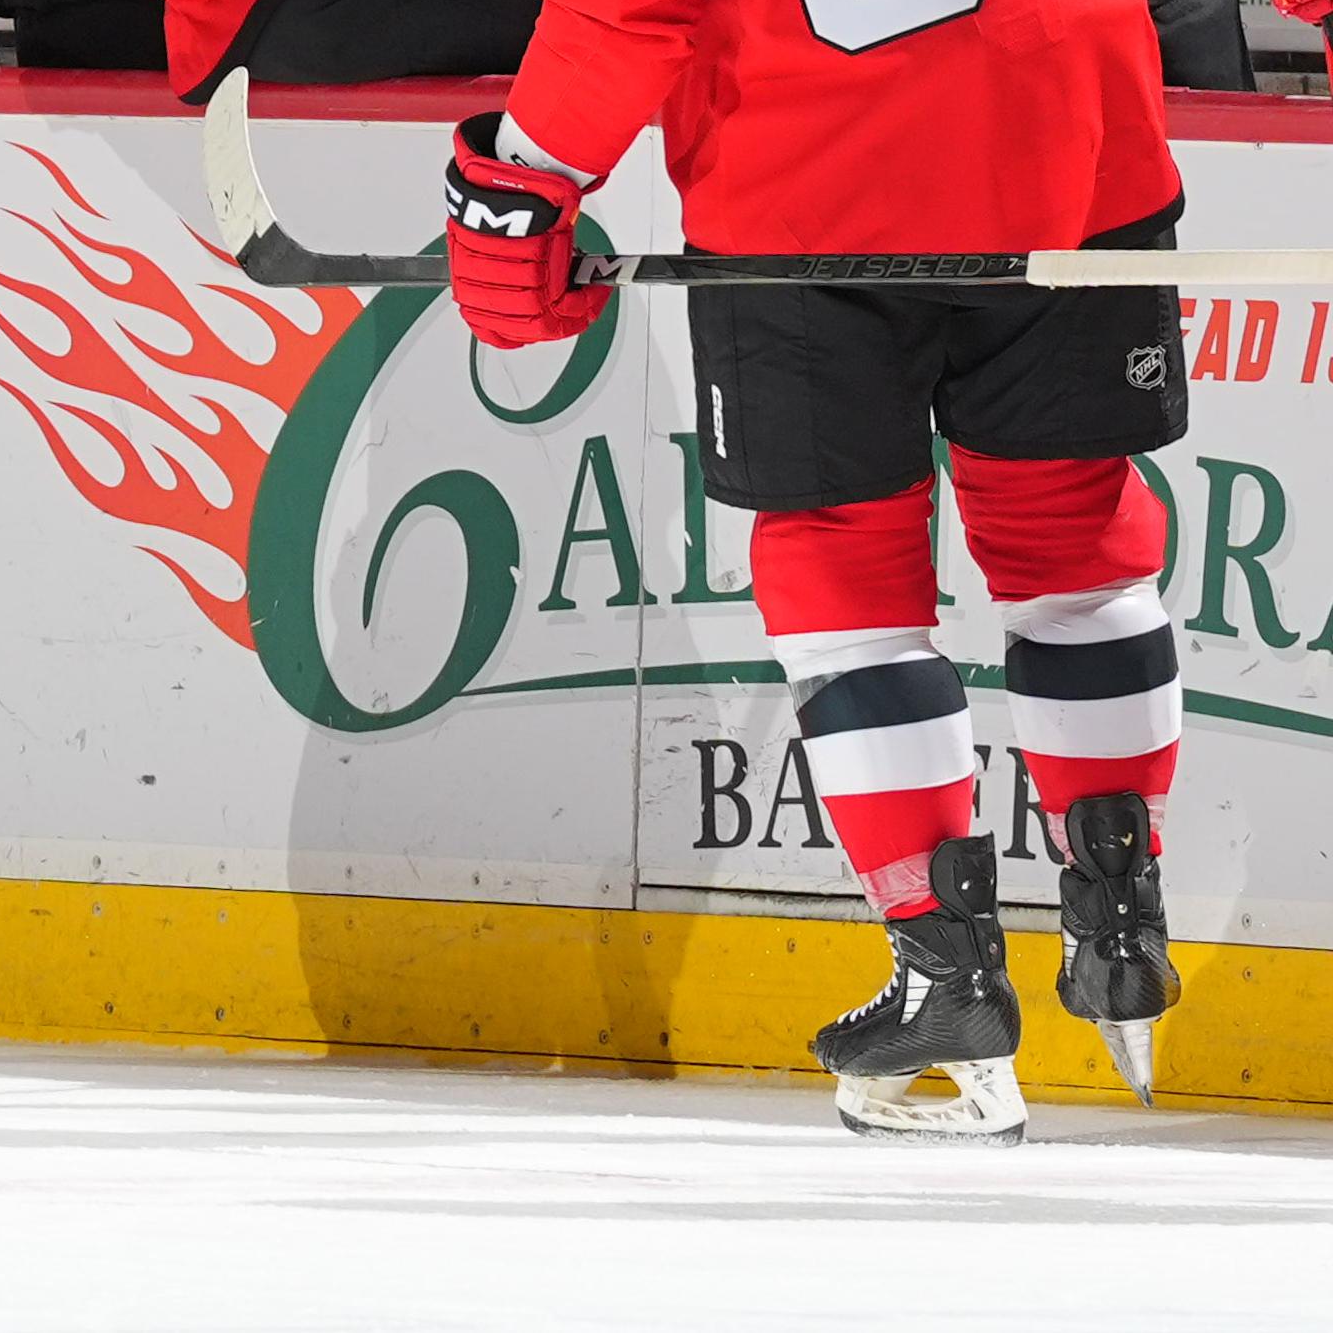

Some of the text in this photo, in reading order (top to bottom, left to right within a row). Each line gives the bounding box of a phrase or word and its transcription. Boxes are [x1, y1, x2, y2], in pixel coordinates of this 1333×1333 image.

[445, 181, 533, 237] CM
[788, 255, 985, 279] JETSPEED
[1300, 301, 1333, 384] I
[710, 383, 727, 459] CCM
